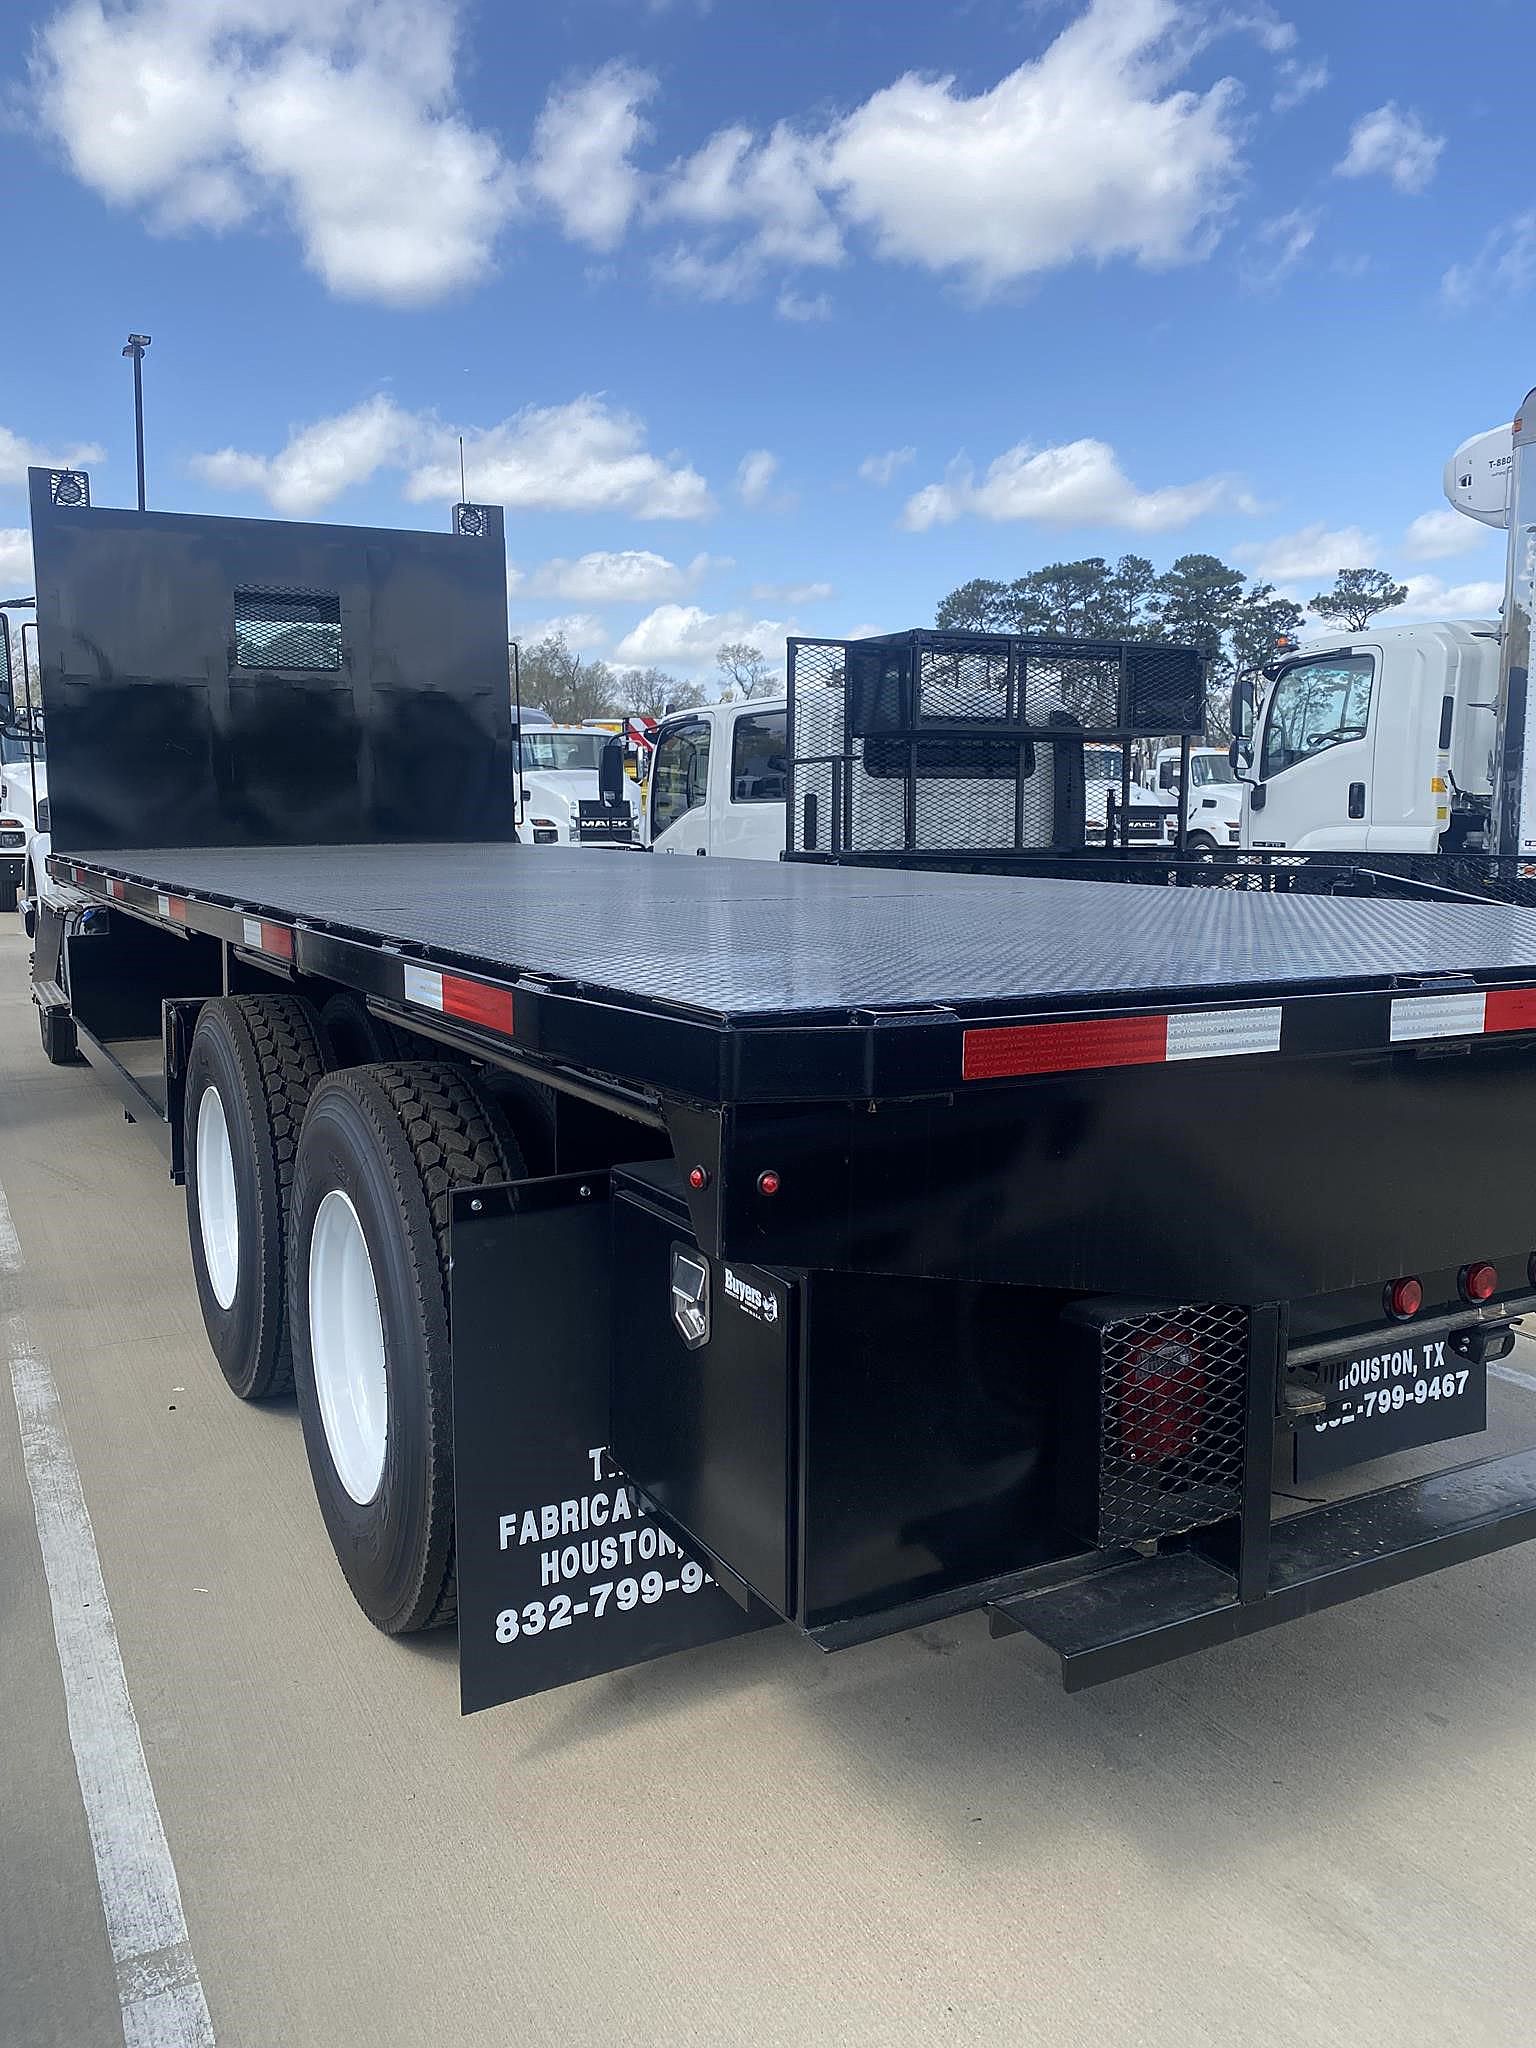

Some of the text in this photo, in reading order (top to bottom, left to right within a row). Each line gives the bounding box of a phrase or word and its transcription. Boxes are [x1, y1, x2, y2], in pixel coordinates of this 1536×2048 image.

[1489, 456, 1513, 468] T-880
[580, 820, 628, 828] MACK
[725, 1268, 762, 1307] Buyers
[1423, 1341, 1445, 1369] TX
[499, 1487, 646, 1550] FABRICA
[540, 1527, 685, 1586] HOUSTON,
